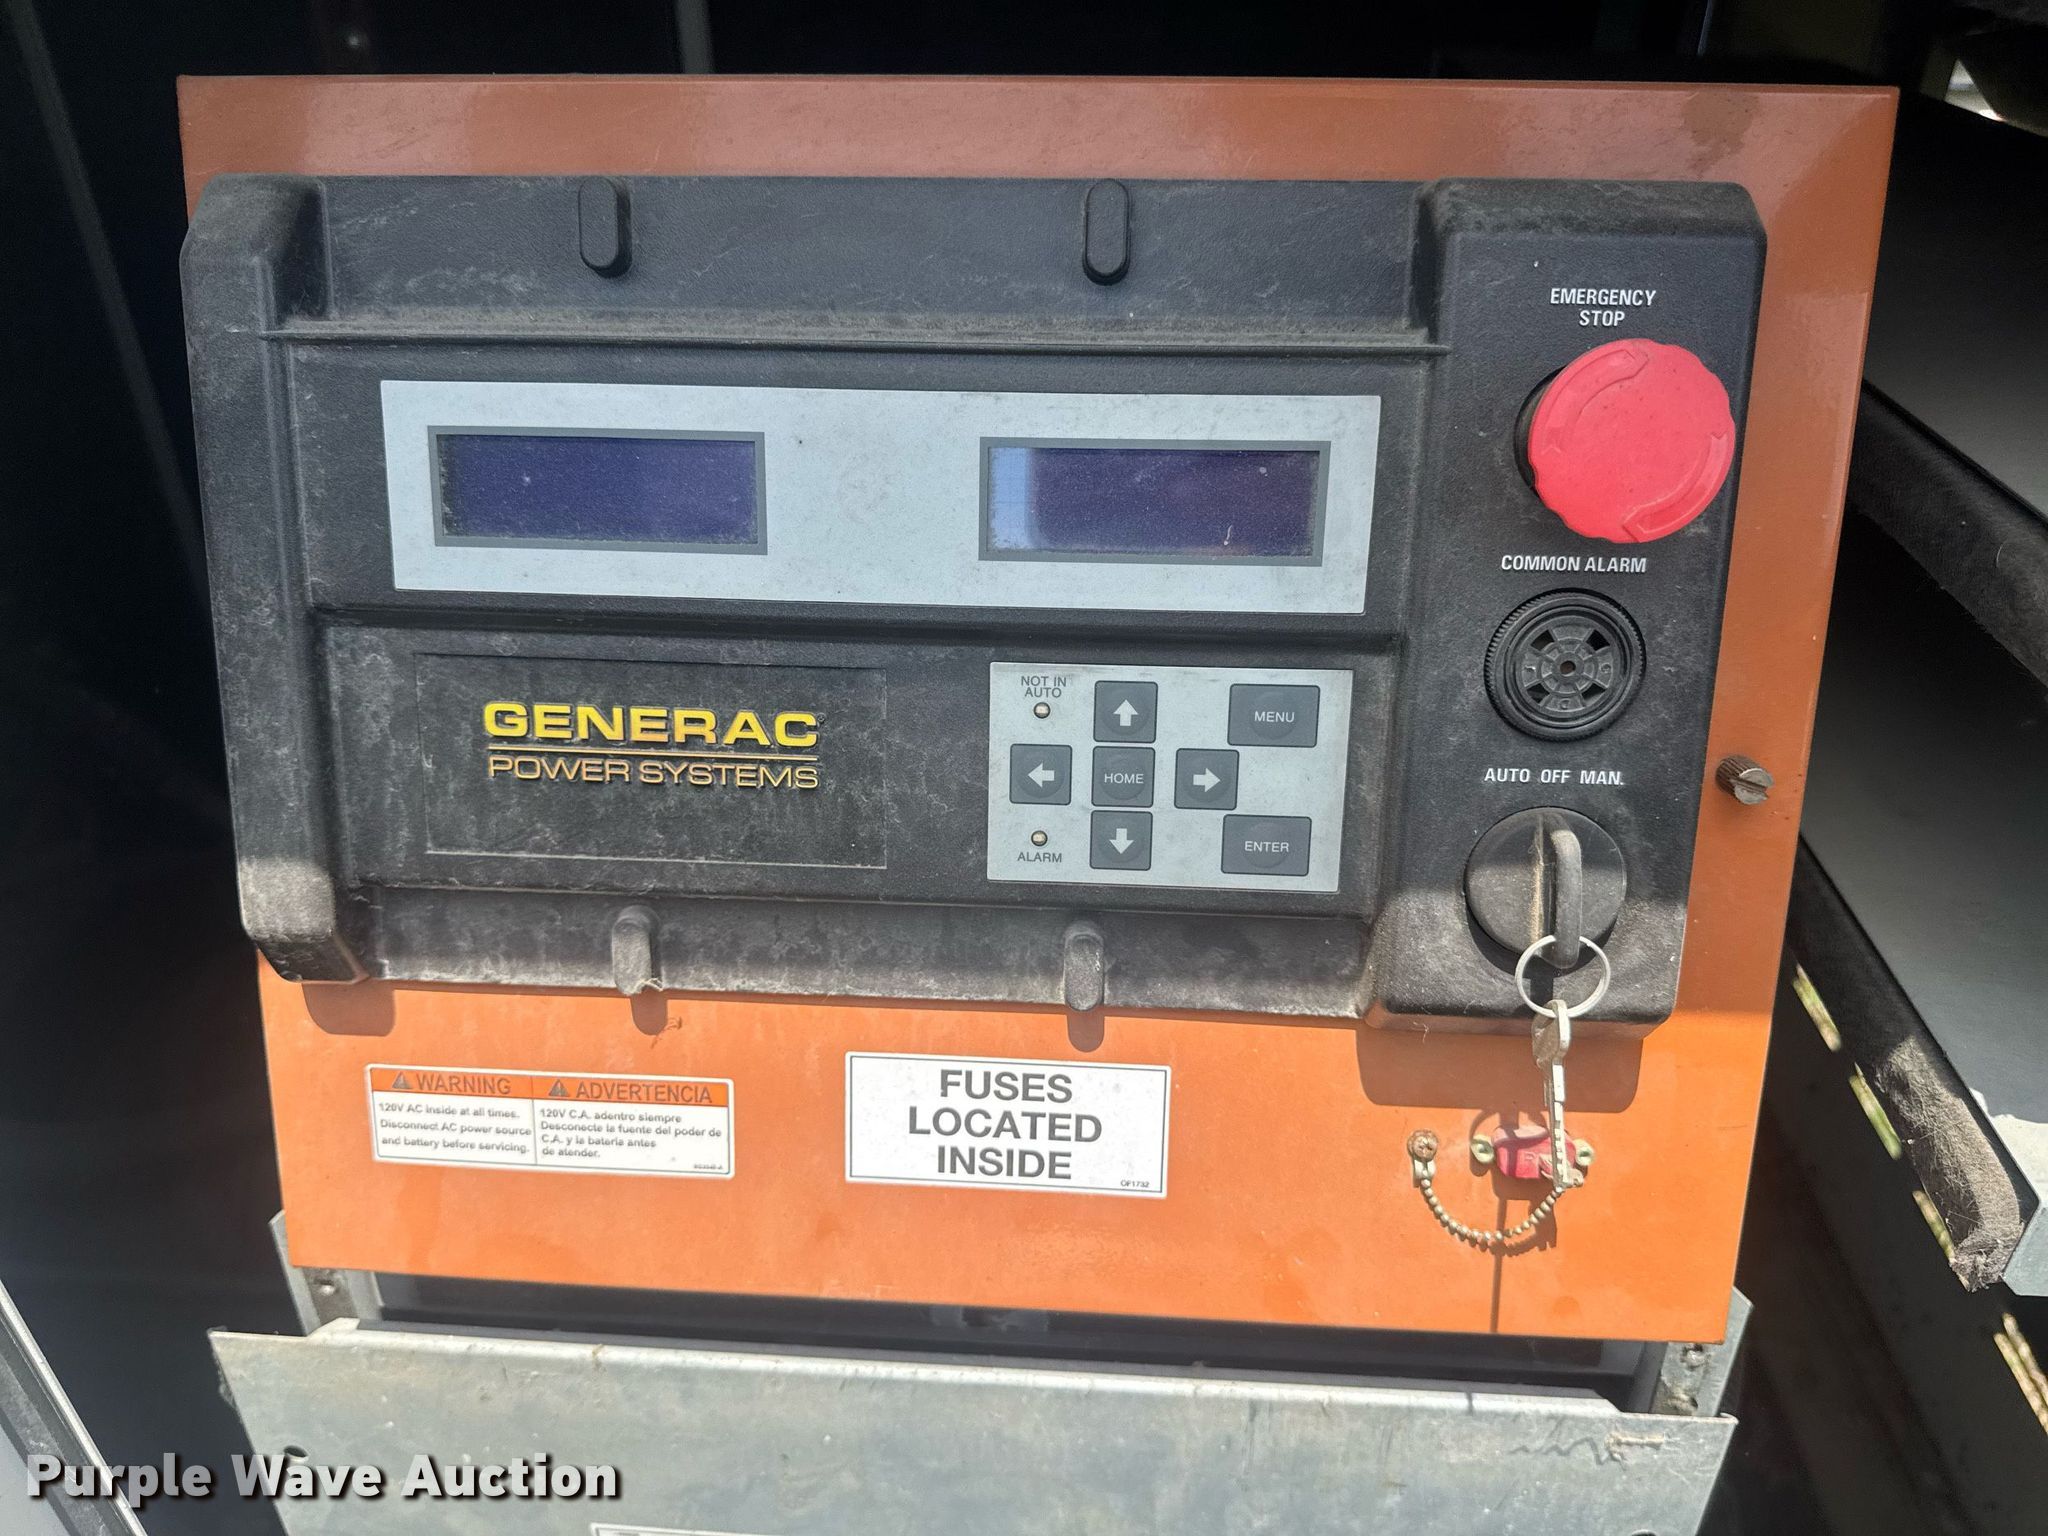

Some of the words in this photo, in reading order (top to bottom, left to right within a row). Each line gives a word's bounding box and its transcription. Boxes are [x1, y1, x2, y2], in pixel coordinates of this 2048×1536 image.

[1550, 288, 1656, 306] EMERGENCY
[1579, 310, 1625, 326] STOP
[1500, 555, 1580, 572] COMMON
[1584, 557, 1647, 573] ALARM
[1021, 675, 1049, 686] NOT
[1054, 677, 1067, 687] IN
[1025, 687, 1062, 698] AUTO
[483, 702, 818, 747] GENERAC
[1254, 711, 1295, 723] MENU
[488, 755, 630, 783] POWER
[639, 761, 820, 789] SYSTEMS
[1104, 773, 1144, 784] HOME
[1484, 768, 1530, 783] AUTO
[1540, 769, 1571, 784] OFF
[1244, 841, 1289, 852] ENTER
[1017, 852, 1062, 863] ALARM
[415, 1073, 511, 1095] WARNING
[576, 1081, 713, 1103] ADVERTENCIA
[940, 1068, 1073, 1103] FUSES
[378, 1102, 403, 1112] 120V
[407, 1104, 423, 1113] AC
[460, 1107, 470, 1116] at
[473, 1107, 485, 1117] all
[487, 1108, 520, 1118] times.
[540, 1108, 566, 1118] 120V
[569, 1109, 590, 1119] C.A.
[594, 1110, 635, 1121] adentro
[638, 1113, 682, 1123] siempre
[380, 1119, 438, 1131] Disconnect
[441, 1122, 457, 1131] AC
[460, 1124, 492, 1134] power
[495, 1126, 532, 1136] source
[540, 1121, 603, 1132] Desconecte
[606, 1123, 615, 1133] la
[618, 1123, 652, 1134] fuente
[655, 1125, 671, 1135] del
[674, 1127, 706, 1138] poder
[709, 1127, 722, 1137] de
[908, 1106, 1102, 1142] LOCATED
[382, 1136, 401, 1145] and
[404, 1136, 439, 1149] battery
[442, 1138, 476, 1150] before
[478, 1142, 530, 1154] servicing.
[541, 1134, 563, 1144] C.A.
[566, 1136, 573, 1146] y
[576, 1135, 584, 1144] la
[627, 1138, 656, 1148] antes
[542, 1147, 555, 1156] de
[558, 1148, 601, 1158] atender.
[937, 1145, 1072, 1179] INSIDE
